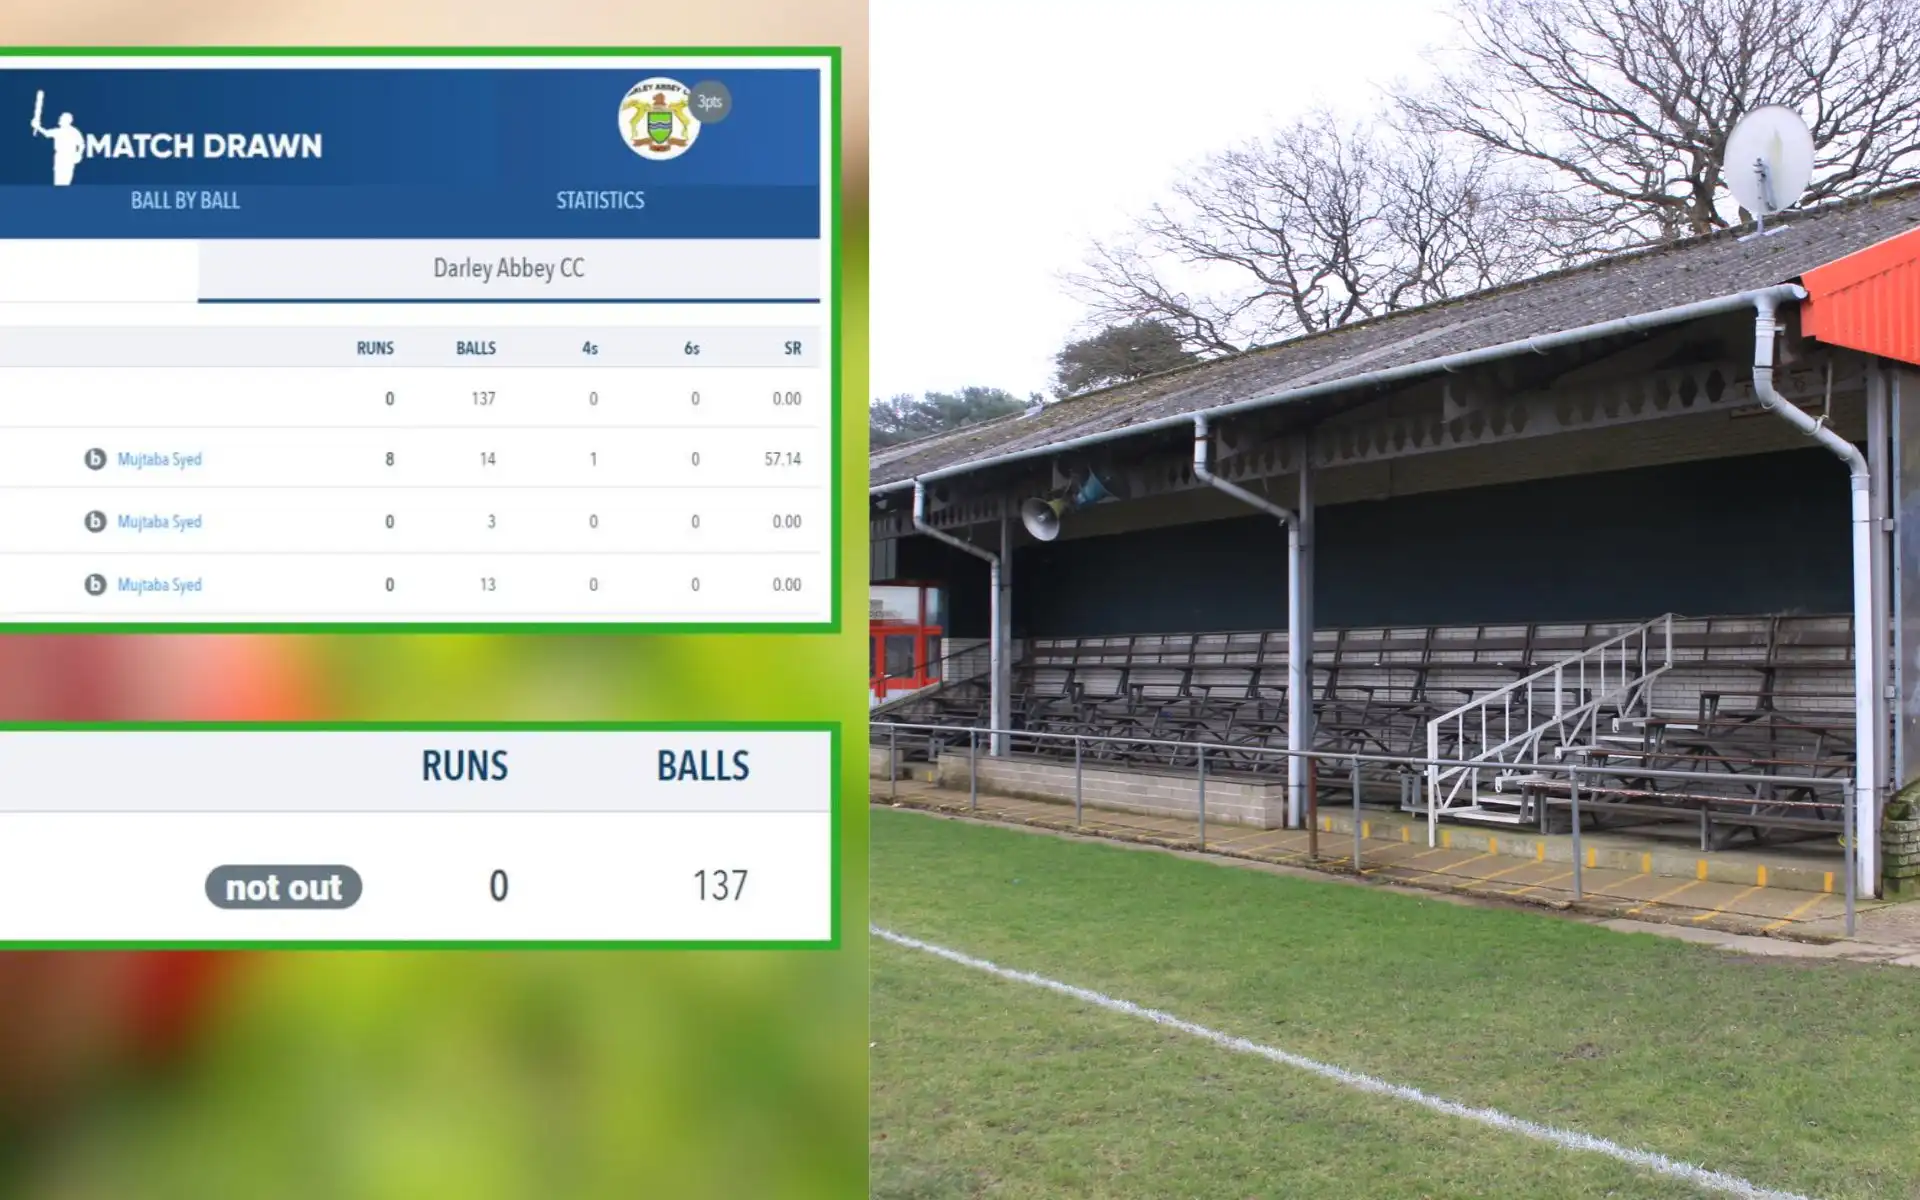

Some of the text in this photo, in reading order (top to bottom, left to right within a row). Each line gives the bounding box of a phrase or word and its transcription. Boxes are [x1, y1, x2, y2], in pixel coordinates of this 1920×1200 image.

[697, 94, 723, 112] 3pts
[86, 132, 322, 160] MATCH DRAWN
[131, 190, 241, 210] BALL BY BALL
[556, 190, 646, 210] STATISTICS
[434, 256, 585, 285] Darley Abbey CC
[357, 340, 802, 356] RUNS BALLS 4s 6s SR
[385, 390, 802, 407] 0 137 0 0 0.00
[117, 451, 170, 470] Mujtaba
[172, 451, 203, 470] Syed
[385, 451, 395, 467] 8
[480, 451, 497, 467] 14
[589, 451, 598, 467] 1
[691, 451, 701, 467] 0
[765, 451, 802, 467] 57.14
[117, 513, 170, 533] Mujtaba
[172, 513, 203, 533] Syed
[385, 513, 395, 530] 0
[487, 513, 497, 530] 3
[589, 513, 600, 530] 0
[691, 513, 701, 530] 0
[772, 513, 802, 530] 0.00
[117, 576, 170, 596] Mujtaba
[172, 576, 203, 596] Syed
[385, 576, 395, 593] 0
[480, 576, 497, 593] 13
[589, 576, 600, 593] 0
[691, 576, 701, 593] 0
[772, 576, 802, 593] 0.00
[423, 749, 750, 782] RUNS BALLS
[226, 869, 749, 902] not out 0 137
